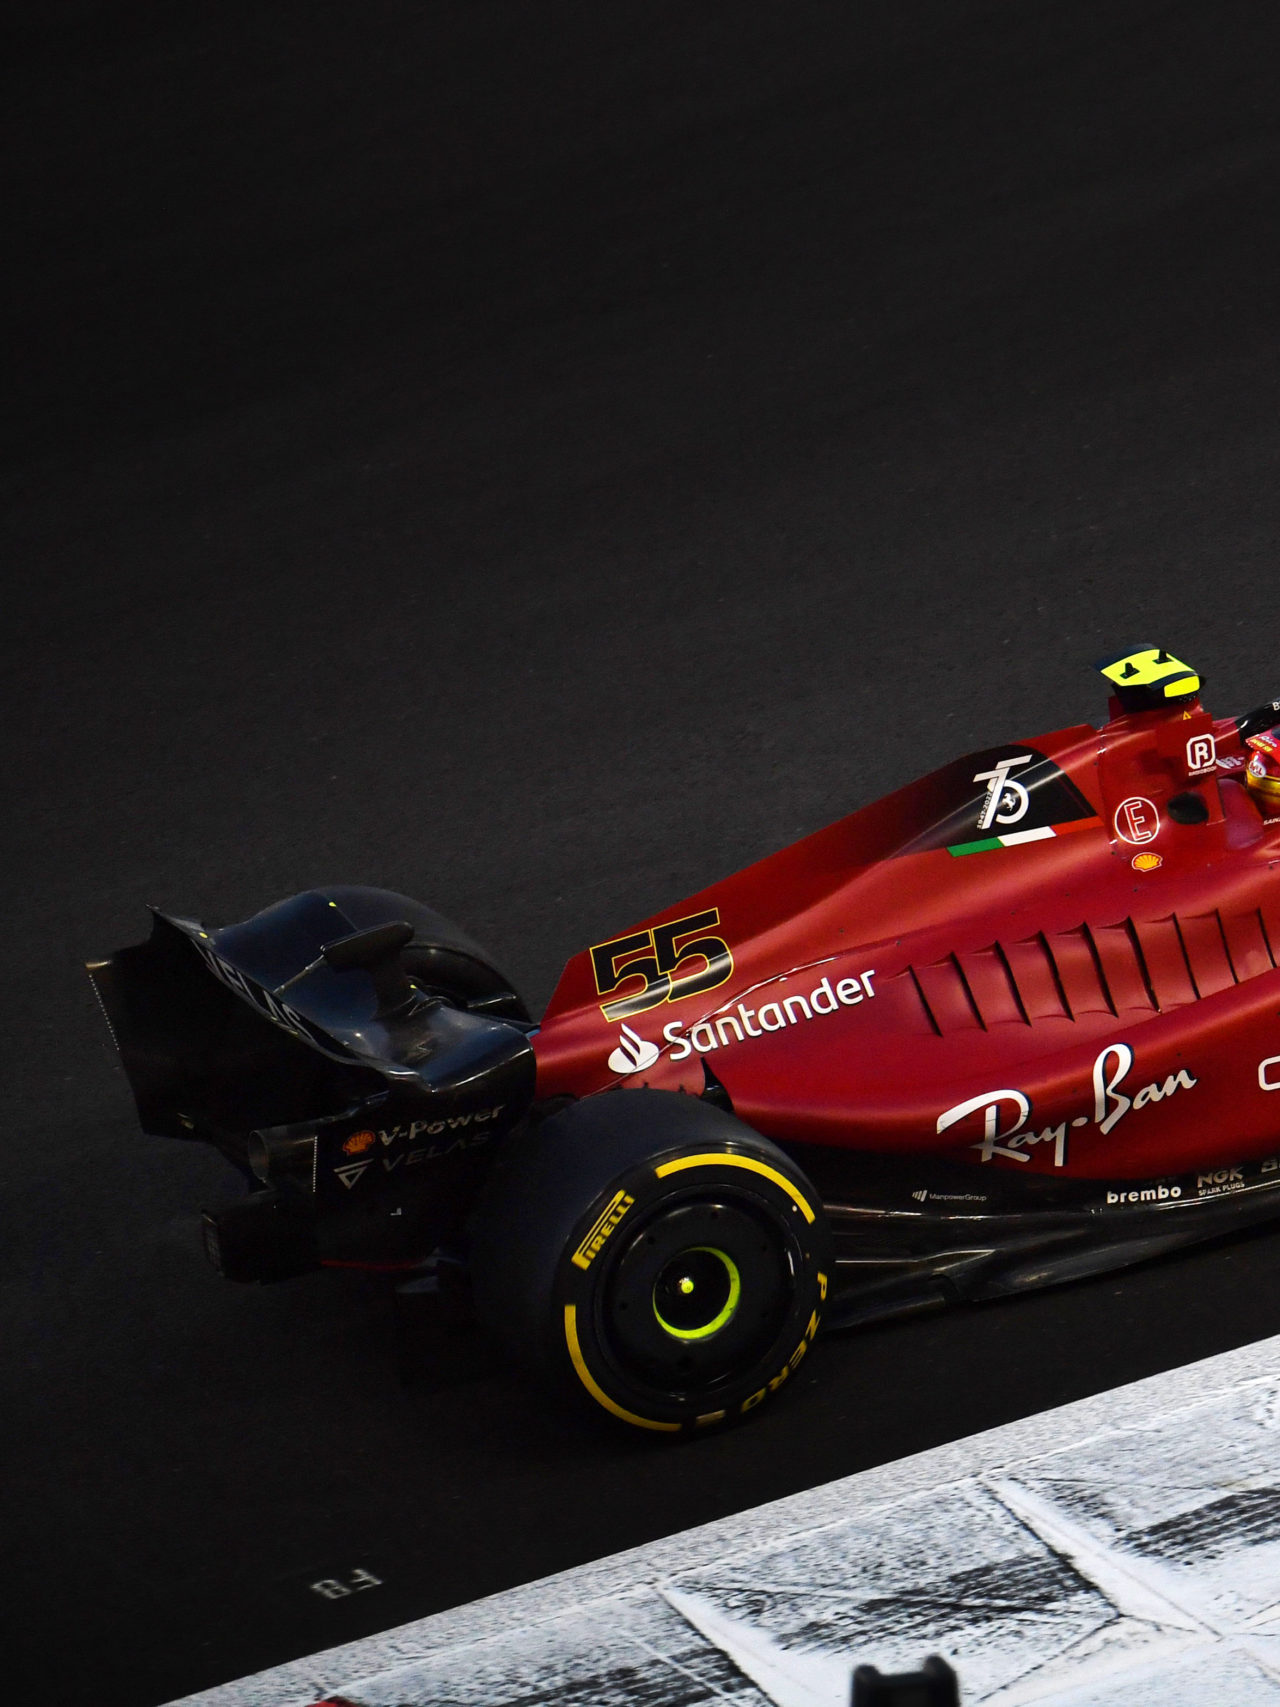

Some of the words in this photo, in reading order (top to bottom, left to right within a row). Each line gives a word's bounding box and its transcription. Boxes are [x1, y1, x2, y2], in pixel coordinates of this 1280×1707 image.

[973, 754, 1032, 829] 75
[1123, 800, 1153, 842] E
[589, 907, 734, 1023] 55
[662, 969, 879, 1061] Santander
[378, 1104, 506, 1147] V-Power
[936, 1042, 1198, 1168] Ray-Ban
[1106, 1185, 1182, 1205] brembo
[1197, 1166, 1245, 1189] NGK
[1222, 1181, 1246, 1193] PLUGS
[571, 1189, 636, 1271] PIRELLI
